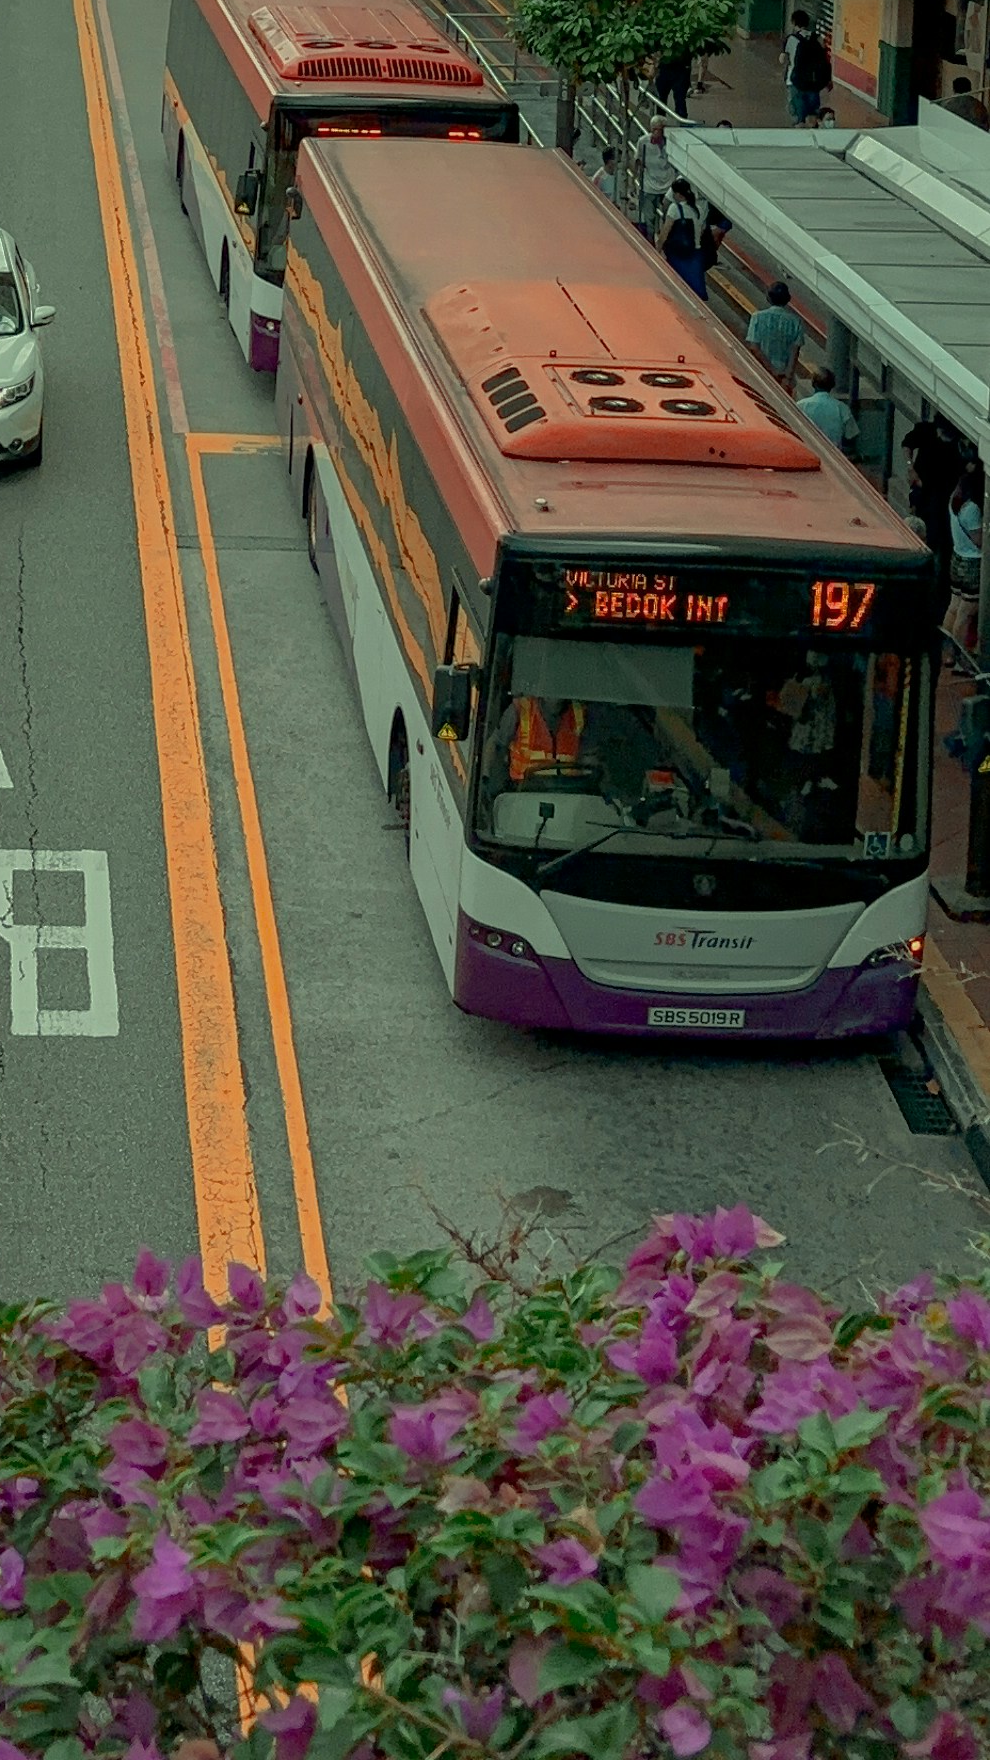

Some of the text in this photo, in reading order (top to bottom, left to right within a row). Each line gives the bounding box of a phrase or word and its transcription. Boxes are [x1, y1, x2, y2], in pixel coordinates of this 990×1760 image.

[594, 590, 729, 623] BEDOK INT
[811, 581, 876, 628] 197
[653, 929, 757, 950] SBS Transit
